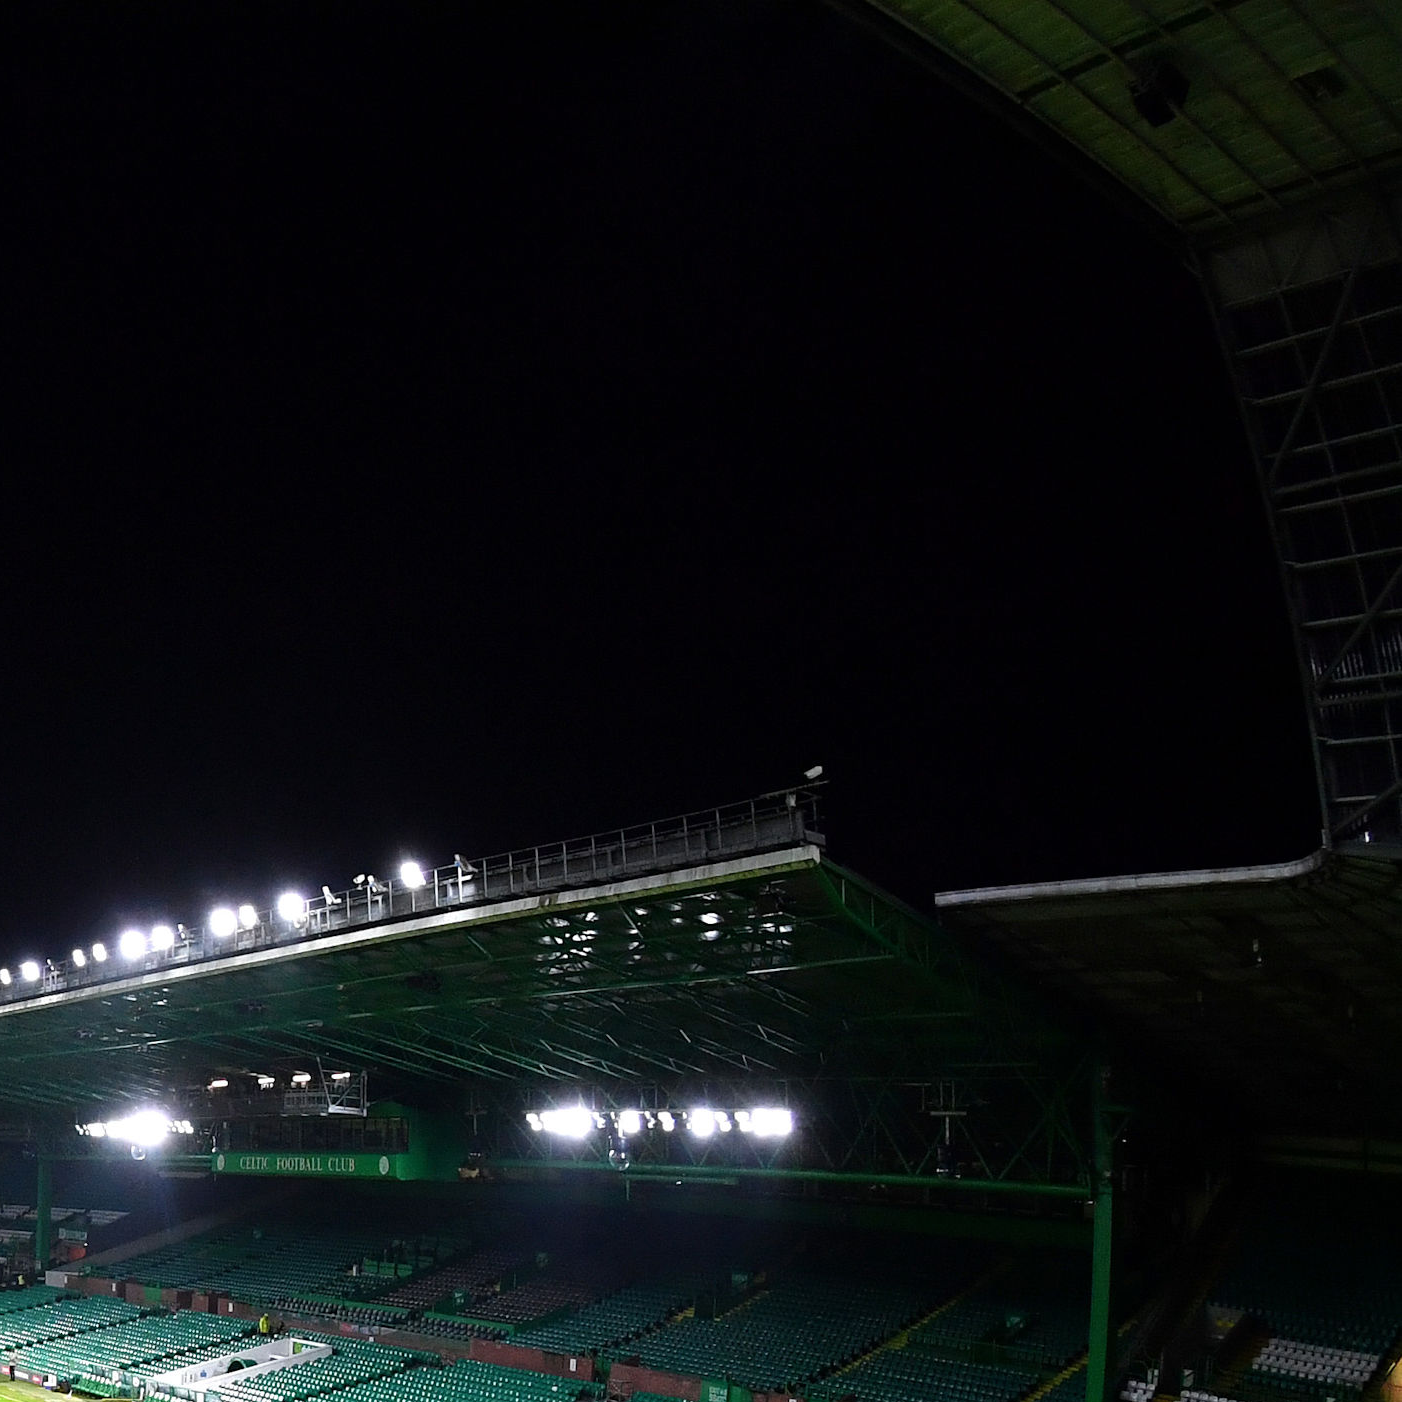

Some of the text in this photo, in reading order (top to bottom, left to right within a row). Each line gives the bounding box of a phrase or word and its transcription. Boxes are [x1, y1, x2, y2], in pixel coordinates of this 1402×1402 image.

[240, 1157, 355, 1172] CELTIC FOOTBALL CLUB
